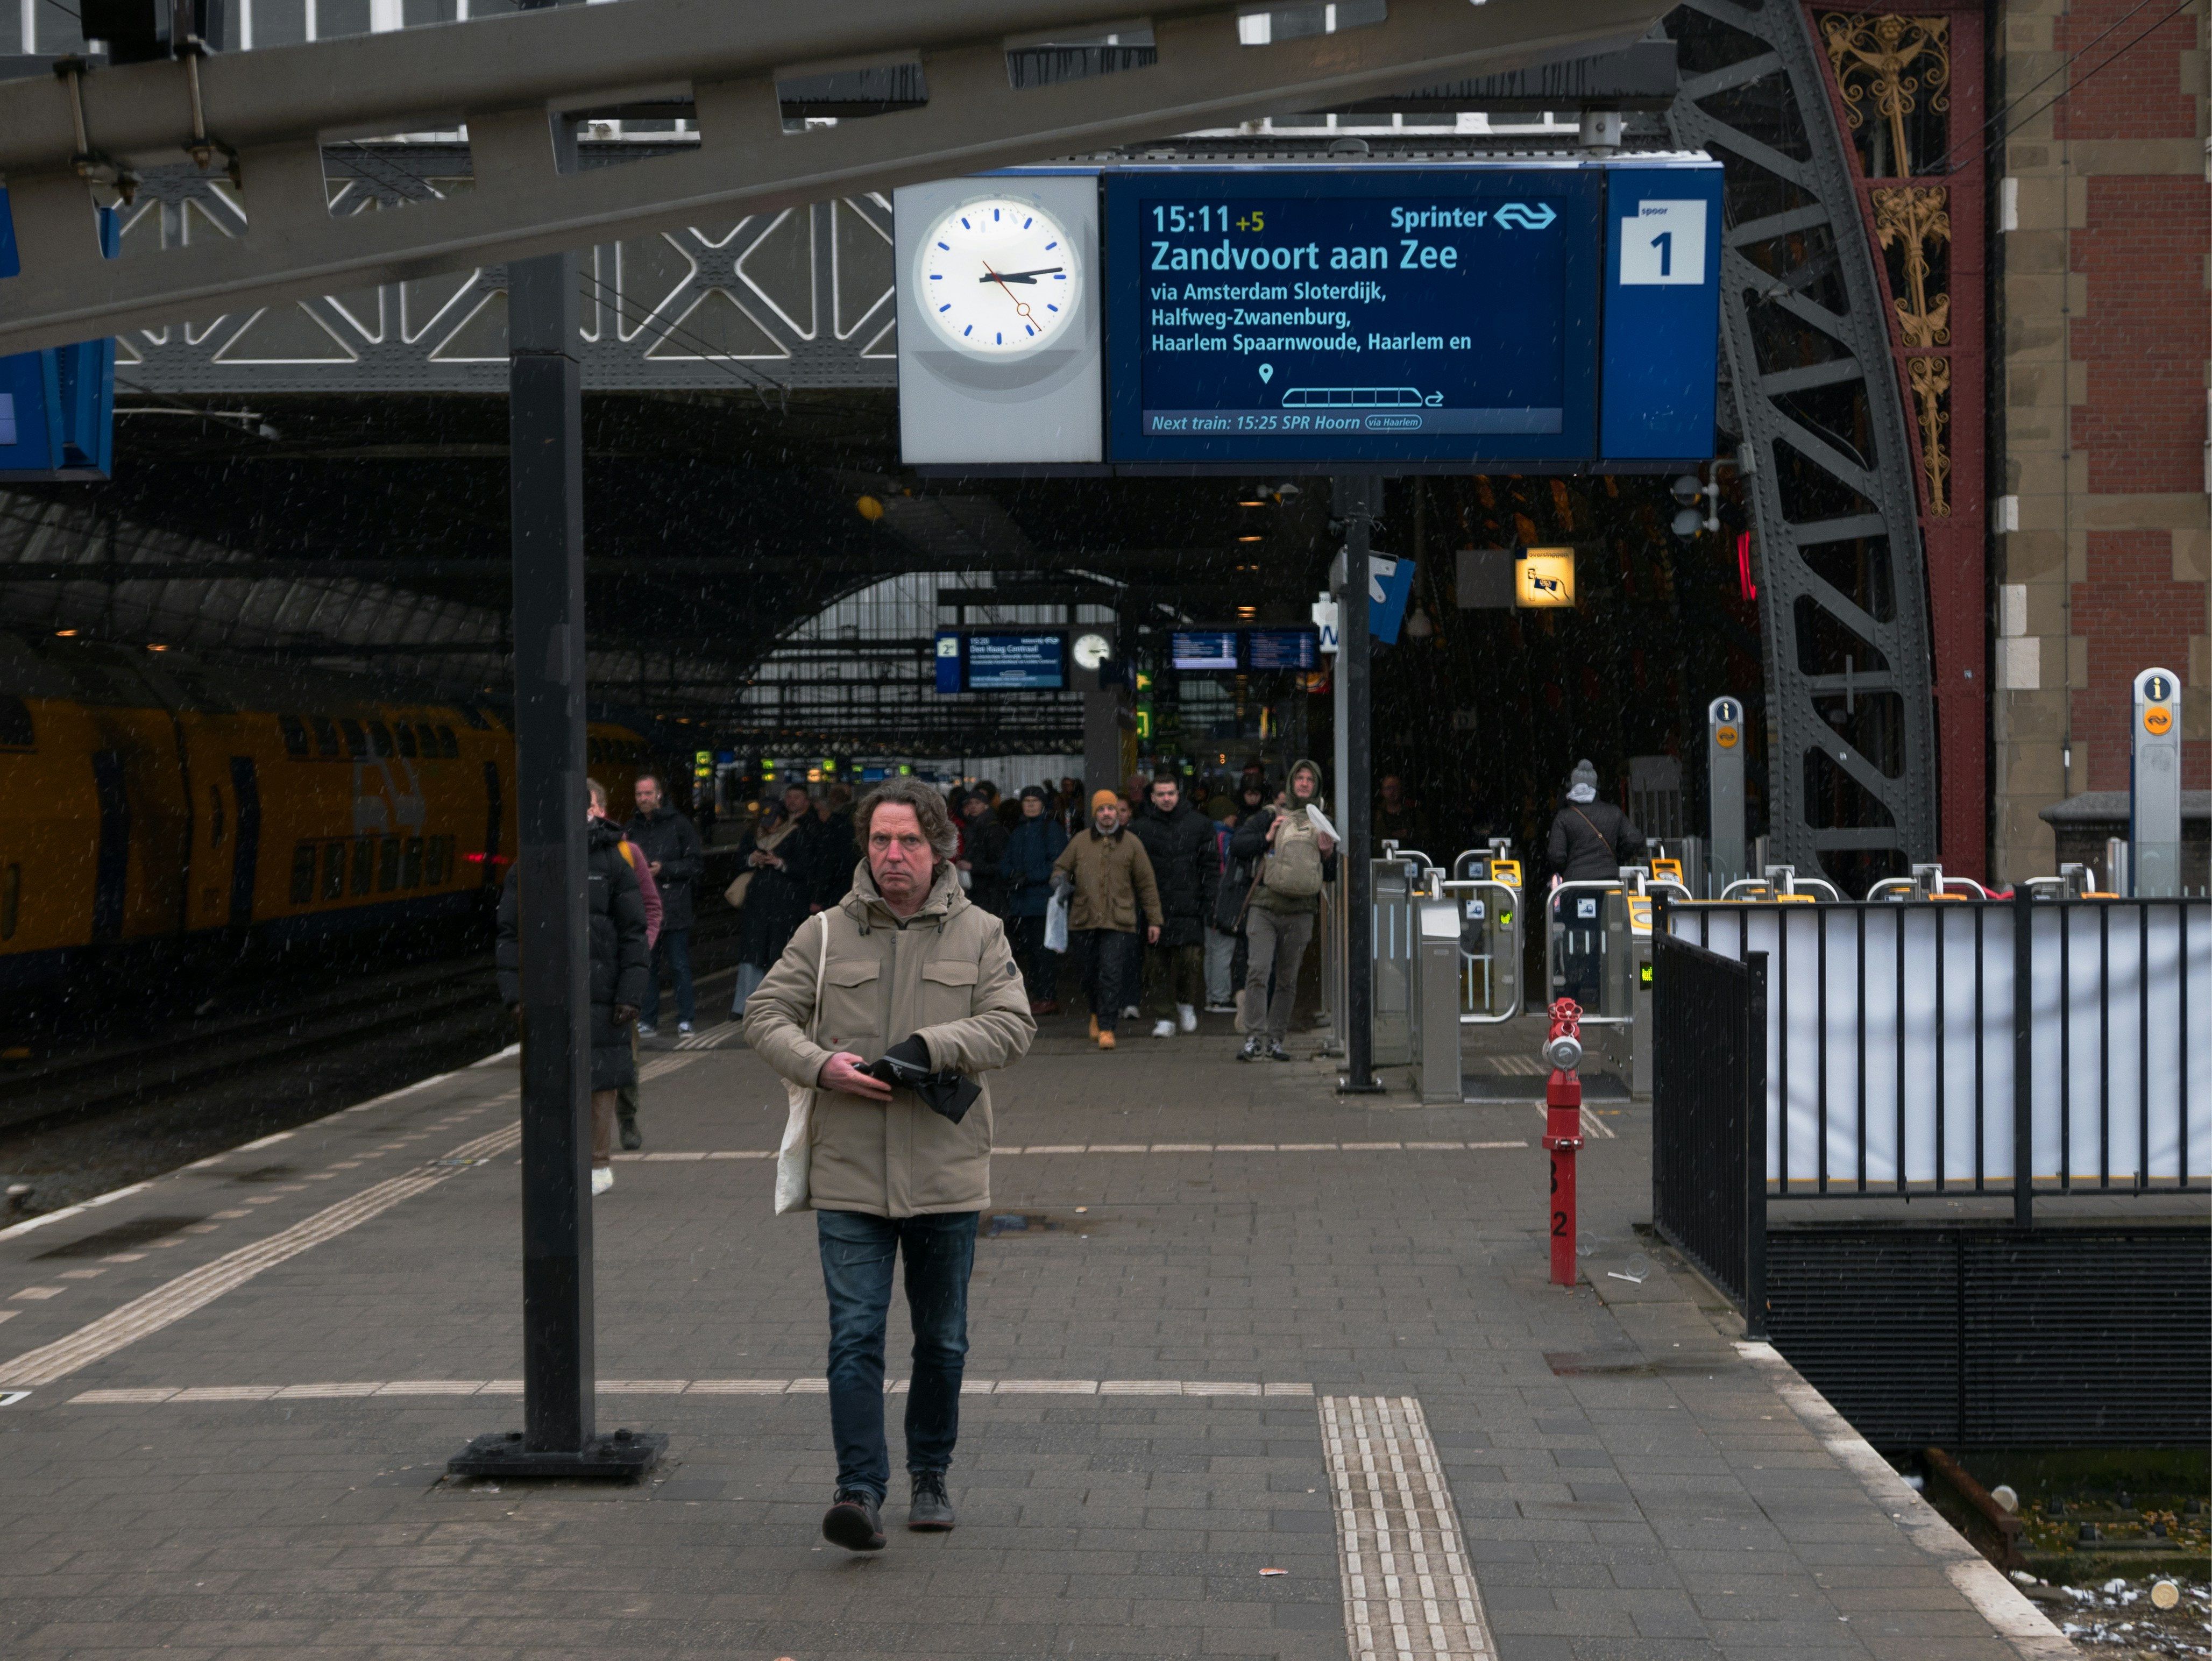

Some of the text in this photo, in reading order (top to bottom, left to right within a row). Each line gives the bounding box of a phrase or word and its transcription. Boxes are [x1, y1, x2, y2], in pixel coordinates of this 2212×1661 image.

[1152, 205, 1265, 233] 15:11 +5
[1391, 206, 1488, 234] Sprinter
[1641, 207, 1668, 217] spoor
[1152, 239, 1458, 271] Zandvoort aan Zee
[1650, 231, 1672, 276] 1
[1151, 281, 1387, 304] via Amsterdam Sloterdijk,
[1152, 307, 1352, 330] Halfweg-Zwanenburg,
[1152, 332, 1472, 356] Haarlem Spaarnwoude, Haarlem en
[1152, 415, 1361, 430] Next train: 15:25 SPR Hoorn
[1369, 417, 1419, 427] via Haarlem
